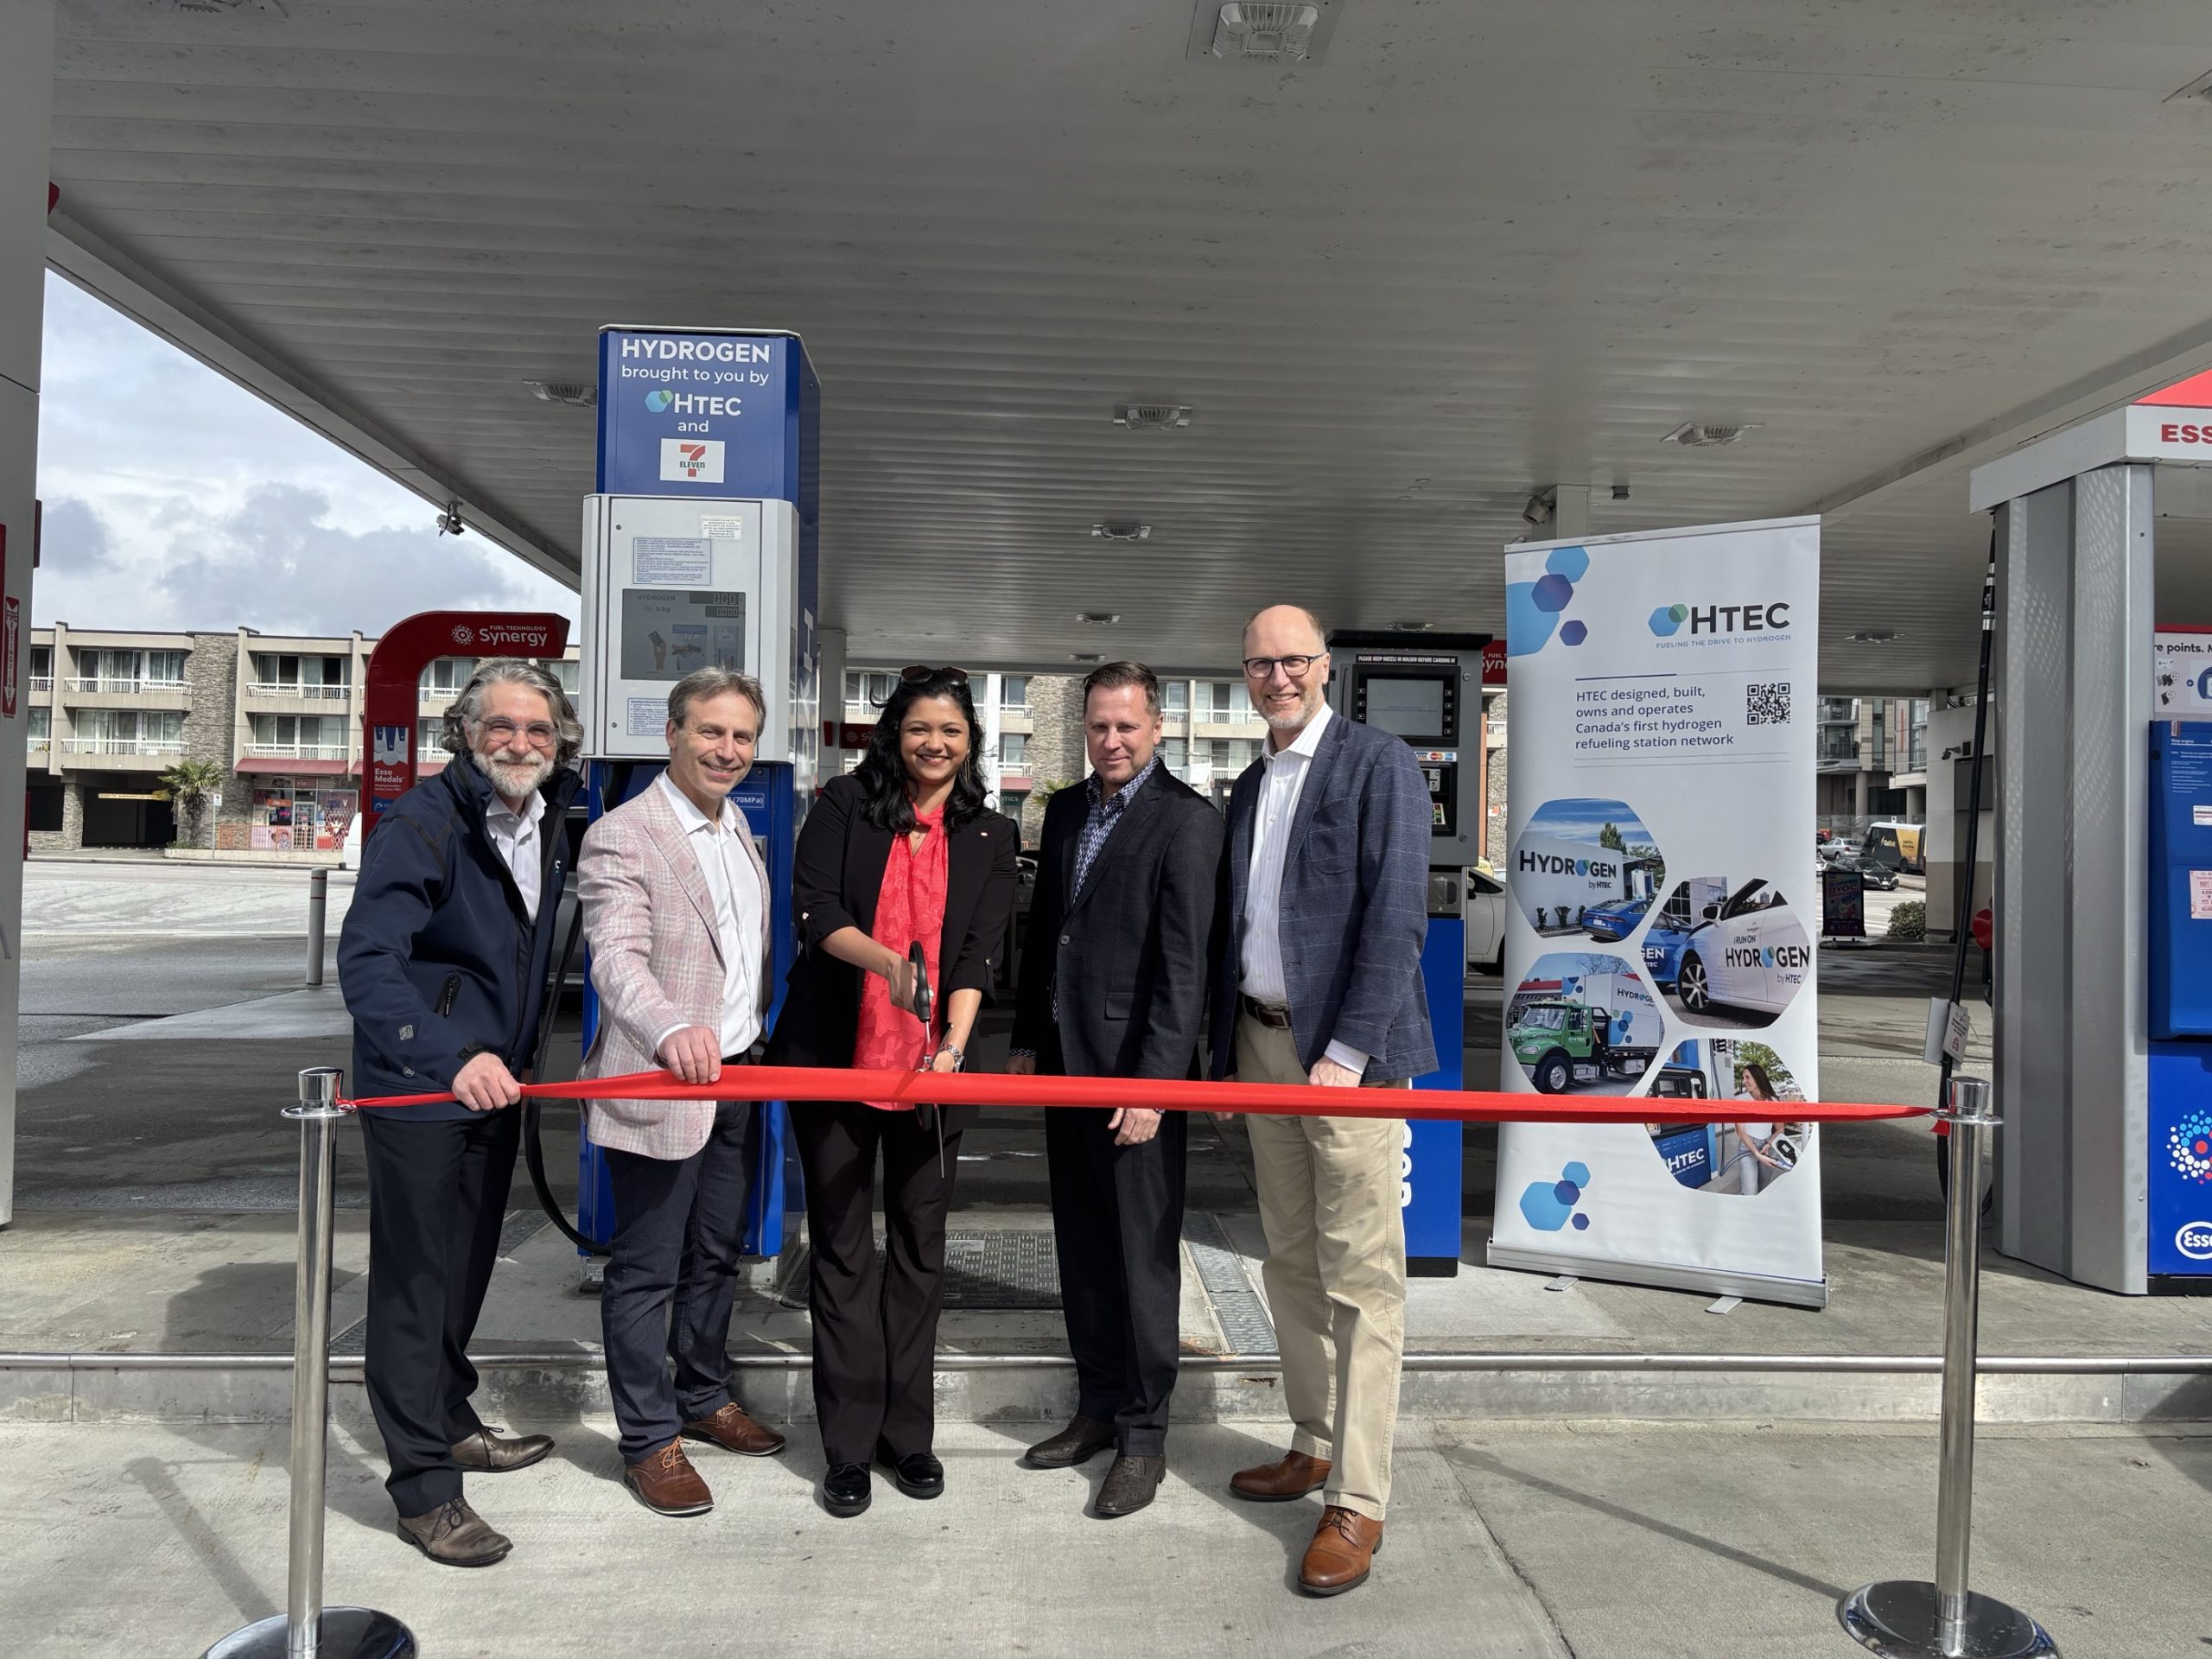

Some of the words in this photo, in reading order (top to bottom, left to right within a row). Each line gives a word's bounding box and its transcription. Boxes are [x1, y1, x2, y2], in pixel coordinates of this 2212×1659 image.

[621, 338, 770, 364] HYDROGEN
[621, 365, 689, 382] brought
[693, 369, 709, 381] to
[714, 371, 744, 384] you
[749, 370, 769, 385] by
[674, 393, 742, 416] HTEC
[677, 420, 709, 433] and
[1691, 602, 1790, 635] HTEC
[479, 628, 548, 647] Synergy
[1707, 638, 1731, 646] DRIVE
[1747, 634, 1791, 643] HYDROGEN
[2166, 643, 2204, 654] points.
[1576, 690, 1608, 702] HTEC
[1611, 688, 1669, 702] designed,
[1674, 686, 1706, 698] built,
[1576, 708, 1608, 718] owns
[1611, 705, 1635, 716] and
[1637, 704, 1694, 717] operates
[1575, 721, 1630, 734] Canada's
[1633, 721, 1659, 732] first
[1662, 720, 1722, 734] hydrogen
[1575, 737, 1630, 751] refueling
[1633, 736, 1677, 747] station
[1681, 734, 1734, 746] network
[733, 796, 764, 804] (70MPa)
[1588, 880, 1596, 890] by
[1736, 936, 1747, 944] RUN
[1747, 935, 1757, 944] ON
[1777, 973, 1784, 983] by
[1785, 973, 1802, 983] HTEC
[1668, 1147, 1705, 1172] HTEC
[2183, 1230, 2212, 1248] Ess
